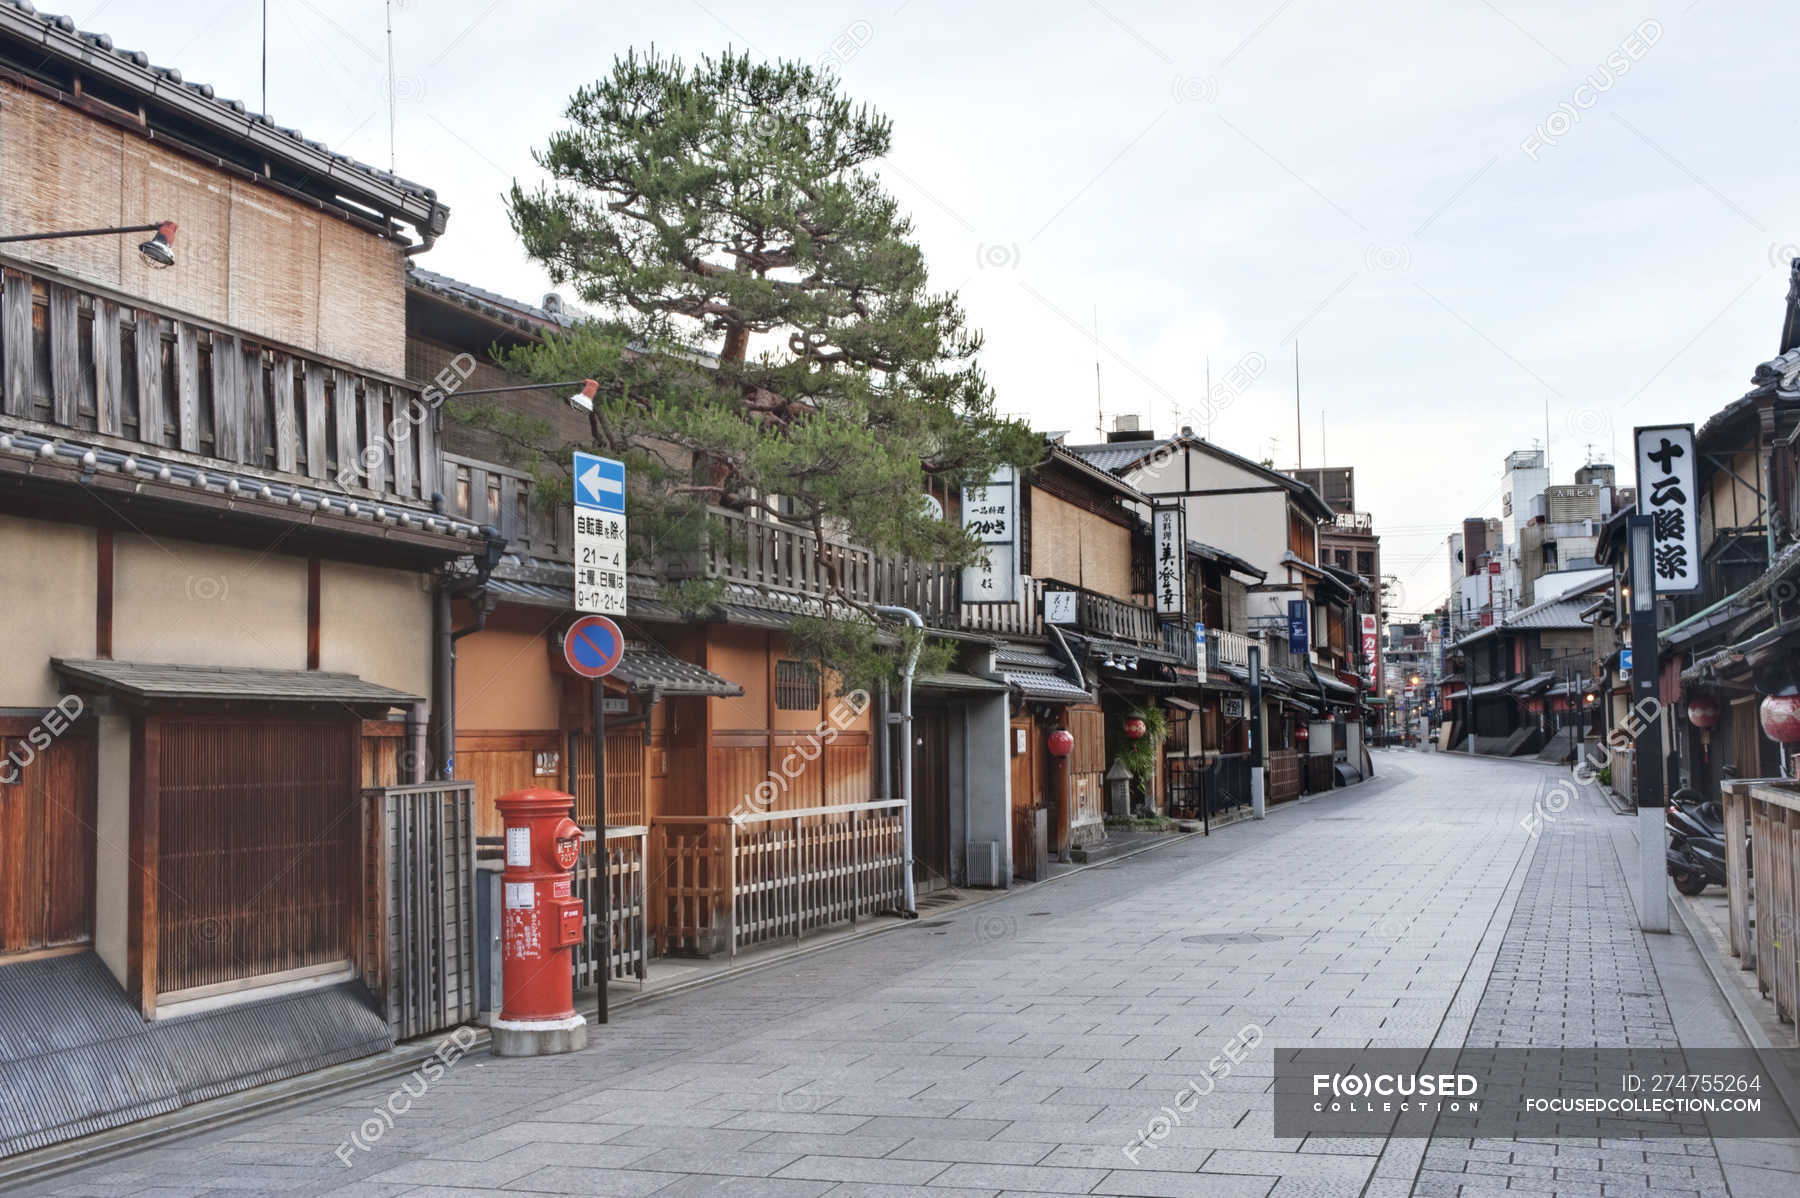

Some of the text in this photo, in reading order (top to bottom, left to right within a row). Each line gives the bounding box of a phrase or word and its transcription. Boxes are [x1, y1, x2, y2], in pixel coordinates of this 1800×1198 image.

[577, 516, 624, 540] 自転車を除く
